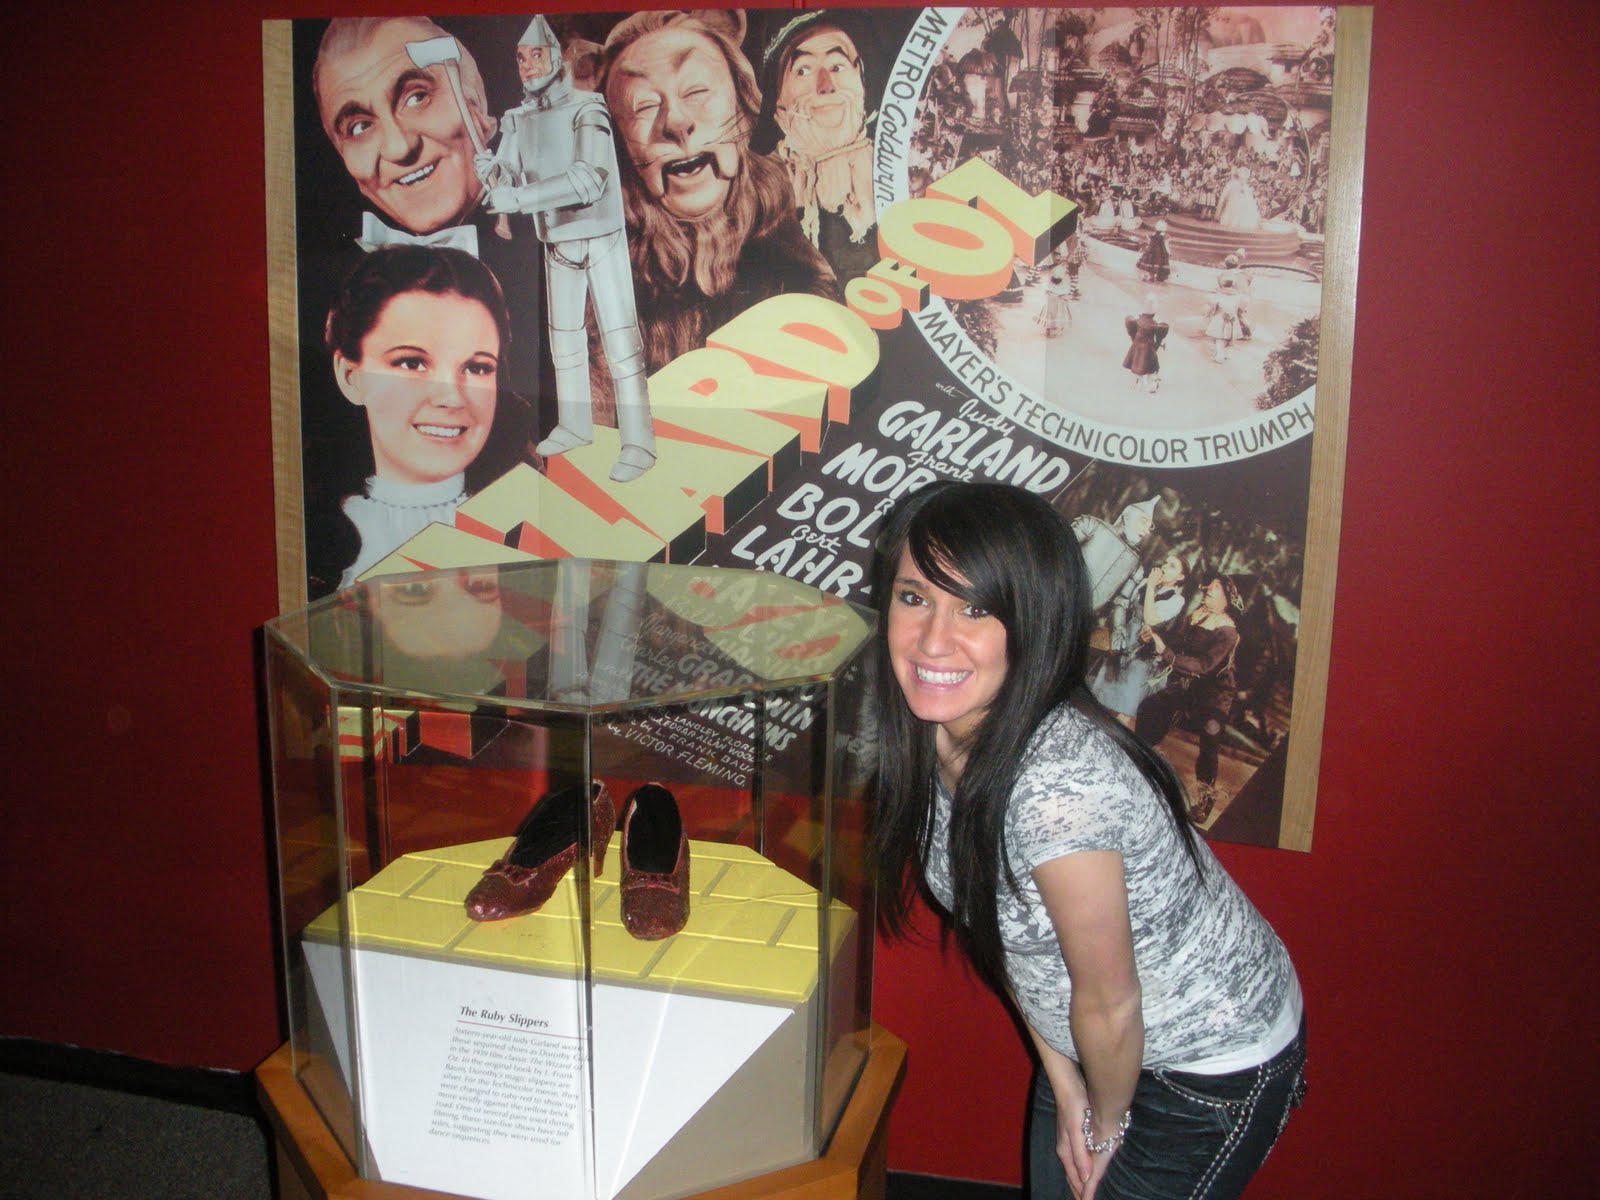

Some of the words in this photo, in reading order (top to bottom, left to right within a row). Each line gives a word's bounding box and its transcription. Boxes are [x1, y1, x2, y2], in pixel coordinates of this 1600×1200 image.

[878, 157, 1077, 301] OZ
[845, 257, 930, 330] OF
[920, 312, 1013, 404] MAYER'S
[1013, 394, 1188, 464] TECHNICOLOR
[1194, 402, 1314, 461] TRIUMPH
[355, 292, 880, 565] IZARD
[958, 398, 1016, 437] Judy
[821, 442, 937, 500] MOR
[878, 401, 1070, 494] GARLAND
[907, 451, 974, 483] Frank
[777, 483, 882, 548] BOL
[791, 525, 841, 555] Bert
[732, 525, 864, 599] LAHR
[625, 728, 674, 756] VICTOR
[663, 720, 696, 738] EDGAR
[728, 747, 755, 763] WOOL
[668, 733, 717, 759] FRANK
[721, 754, 755, 772] BAU
[460, 1006, 478, 1018] The
[480, 1009, 506, 1023] Ruby
[509, 1013, 549, 1028] Slippers
[530, 1038, 560, 1048] Garland
